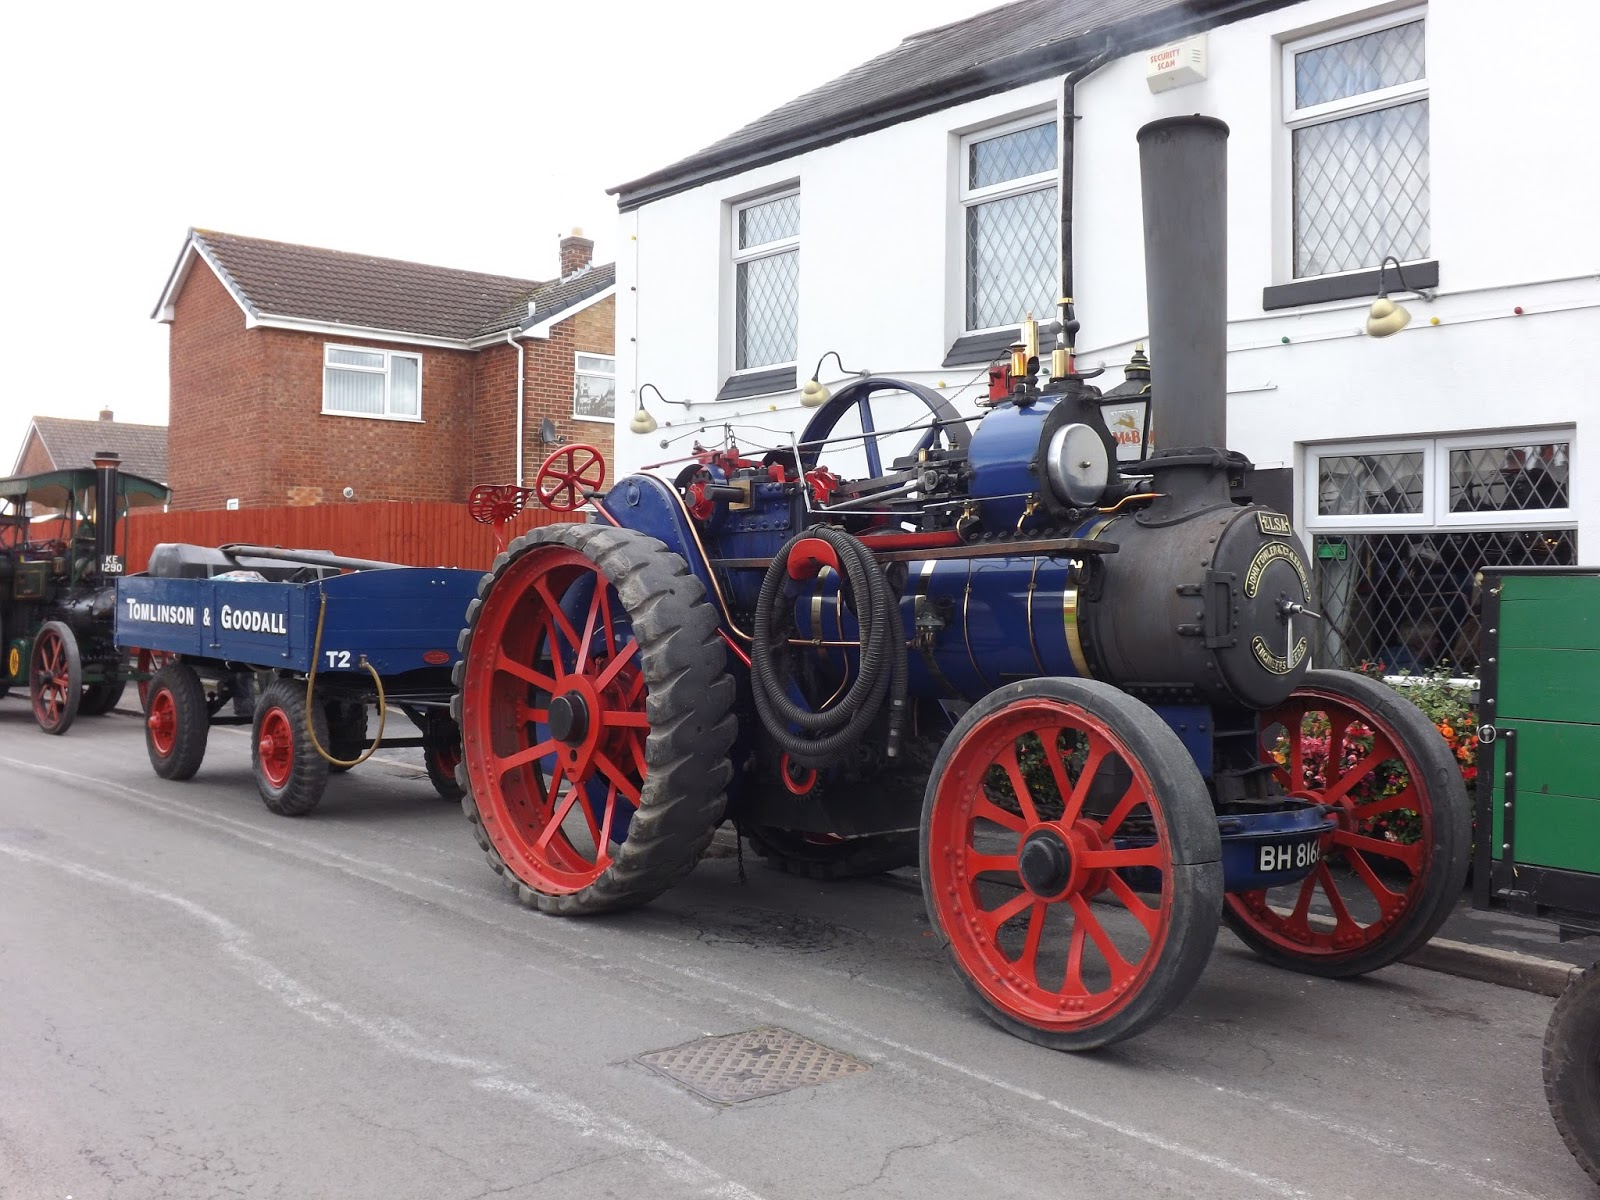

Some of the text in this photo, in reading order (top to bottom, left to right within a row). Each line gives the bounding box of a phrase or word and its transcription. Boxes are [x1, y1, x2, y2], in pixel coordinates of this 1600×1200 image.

[1150, 49, 1180, 64] SECURITY
[1157, 59, 1176, 70] SCAN
[1112, 430, 1141, 444] M&B
[1262, 515, 1289, 532] ELSA
[101, 563, 122, 572] 1290
[105, 555, 119, 564] KE
[1248, 565, 1260, 590] JOHN
[1256, 545, 1278, 569] FOWLER
[126, 598, 287, 635] TOMLINSON & GOODALL
[325, 650, 351, 668] T2
[1260, 845, 1292, 871] BH
